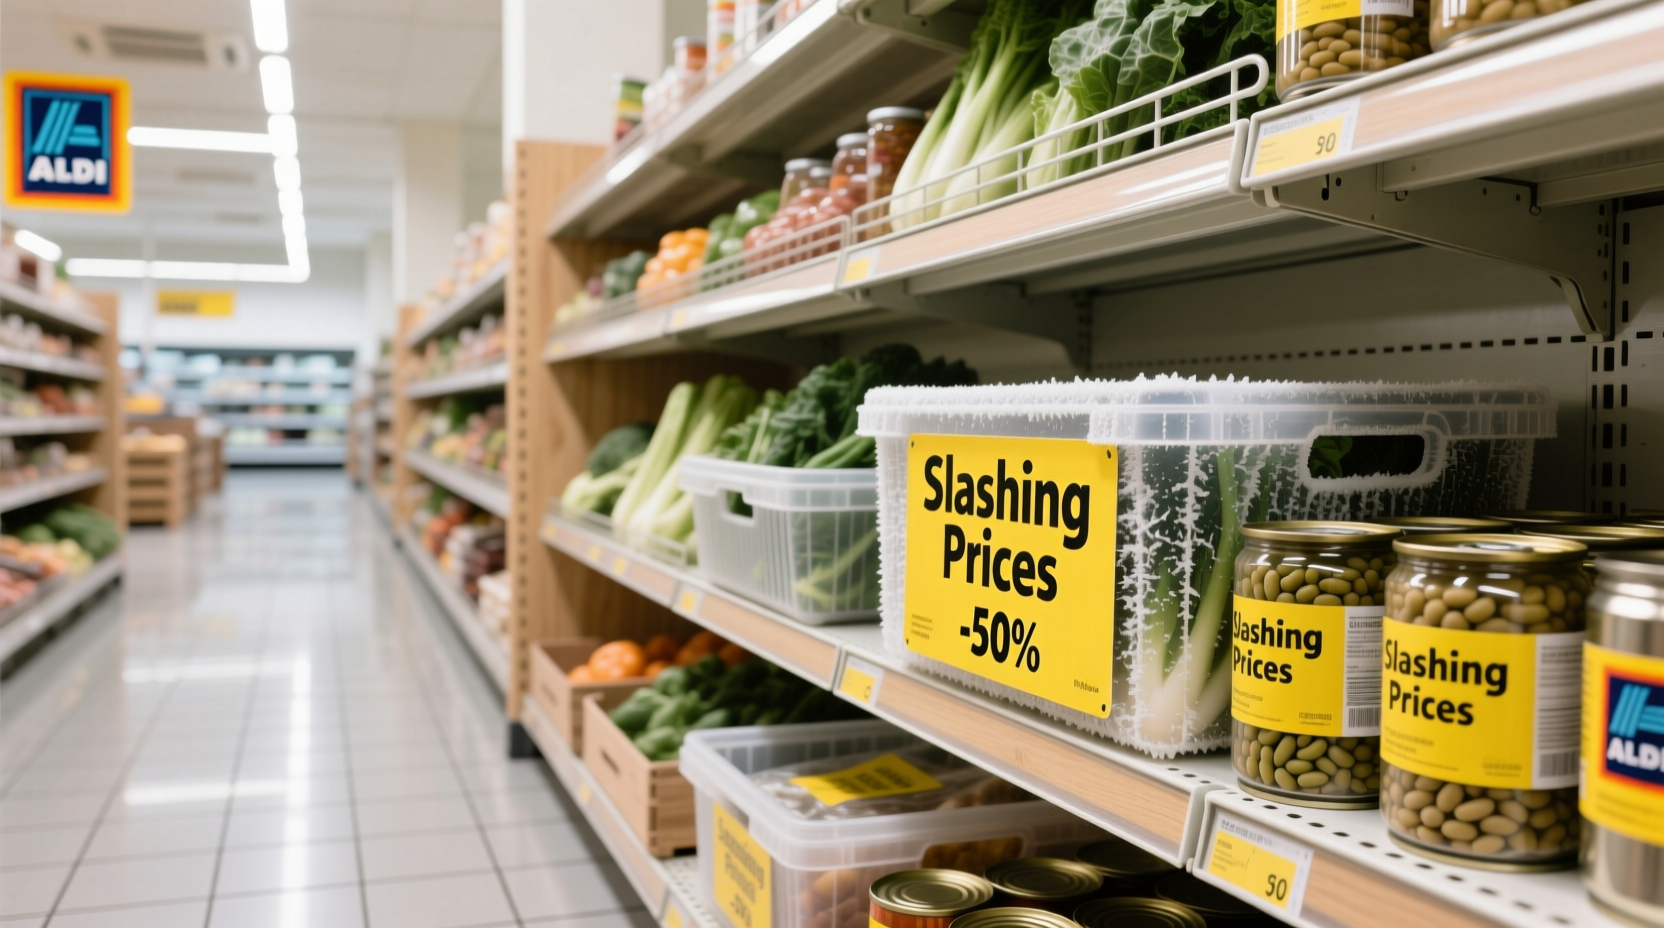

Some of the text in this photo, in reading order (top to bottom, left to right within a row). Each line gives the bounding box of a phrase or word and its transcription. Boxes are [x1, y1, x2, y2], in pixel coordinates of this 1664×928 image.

[28, 155, 108, 185] ALDI
[1315, 132, 1336, 155] 90
[924, 454, 1090, 550] Slashing
[943, 524, 1057, 602] Prices
[960, 606, 1040, 673] -50%
[1233, 644, 1293, 684] Prices
[1384, 638, 1508, 697] Slashing
[1389, 679, 1474, 726] Prices
